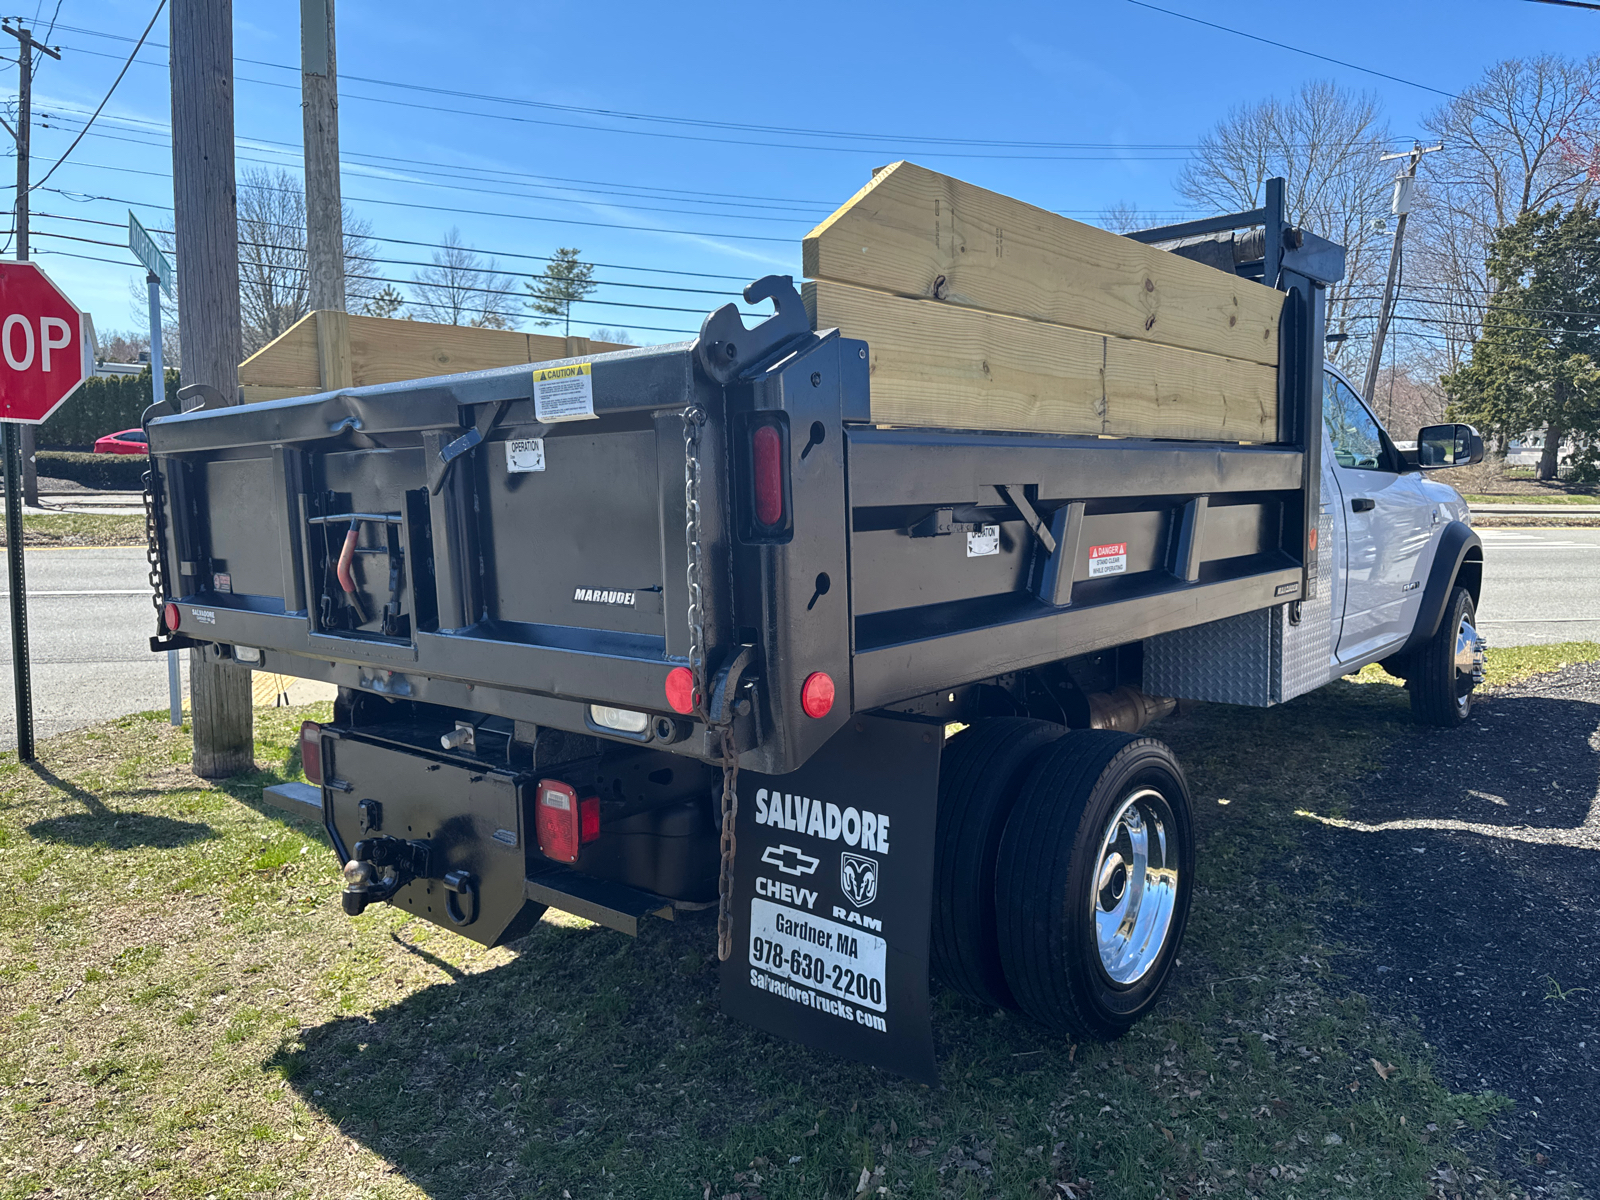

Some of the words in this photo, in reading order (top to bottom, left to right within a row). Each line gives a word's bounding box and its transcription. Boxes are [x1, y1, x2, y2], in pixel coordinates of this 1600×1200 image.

[547, 367, 575, 378] CAUTION
[512, 441, 539, 452] OPERATION
[1098, 546, 1118, 555] DANGER
[1096, 558, 1108, 566] STAND
[1104, 564, 1123, 573] OPERATING
[755, 788, 890, 855] SALVADORE
[755, 876, 819, 910] CHEVY
[832, 905, 883, 933] RAM
[776, 912, 833, 953] Gardner,
[836, 932, 859, 960] MA
[752, 936, 882, 1006] 978-630-2200
